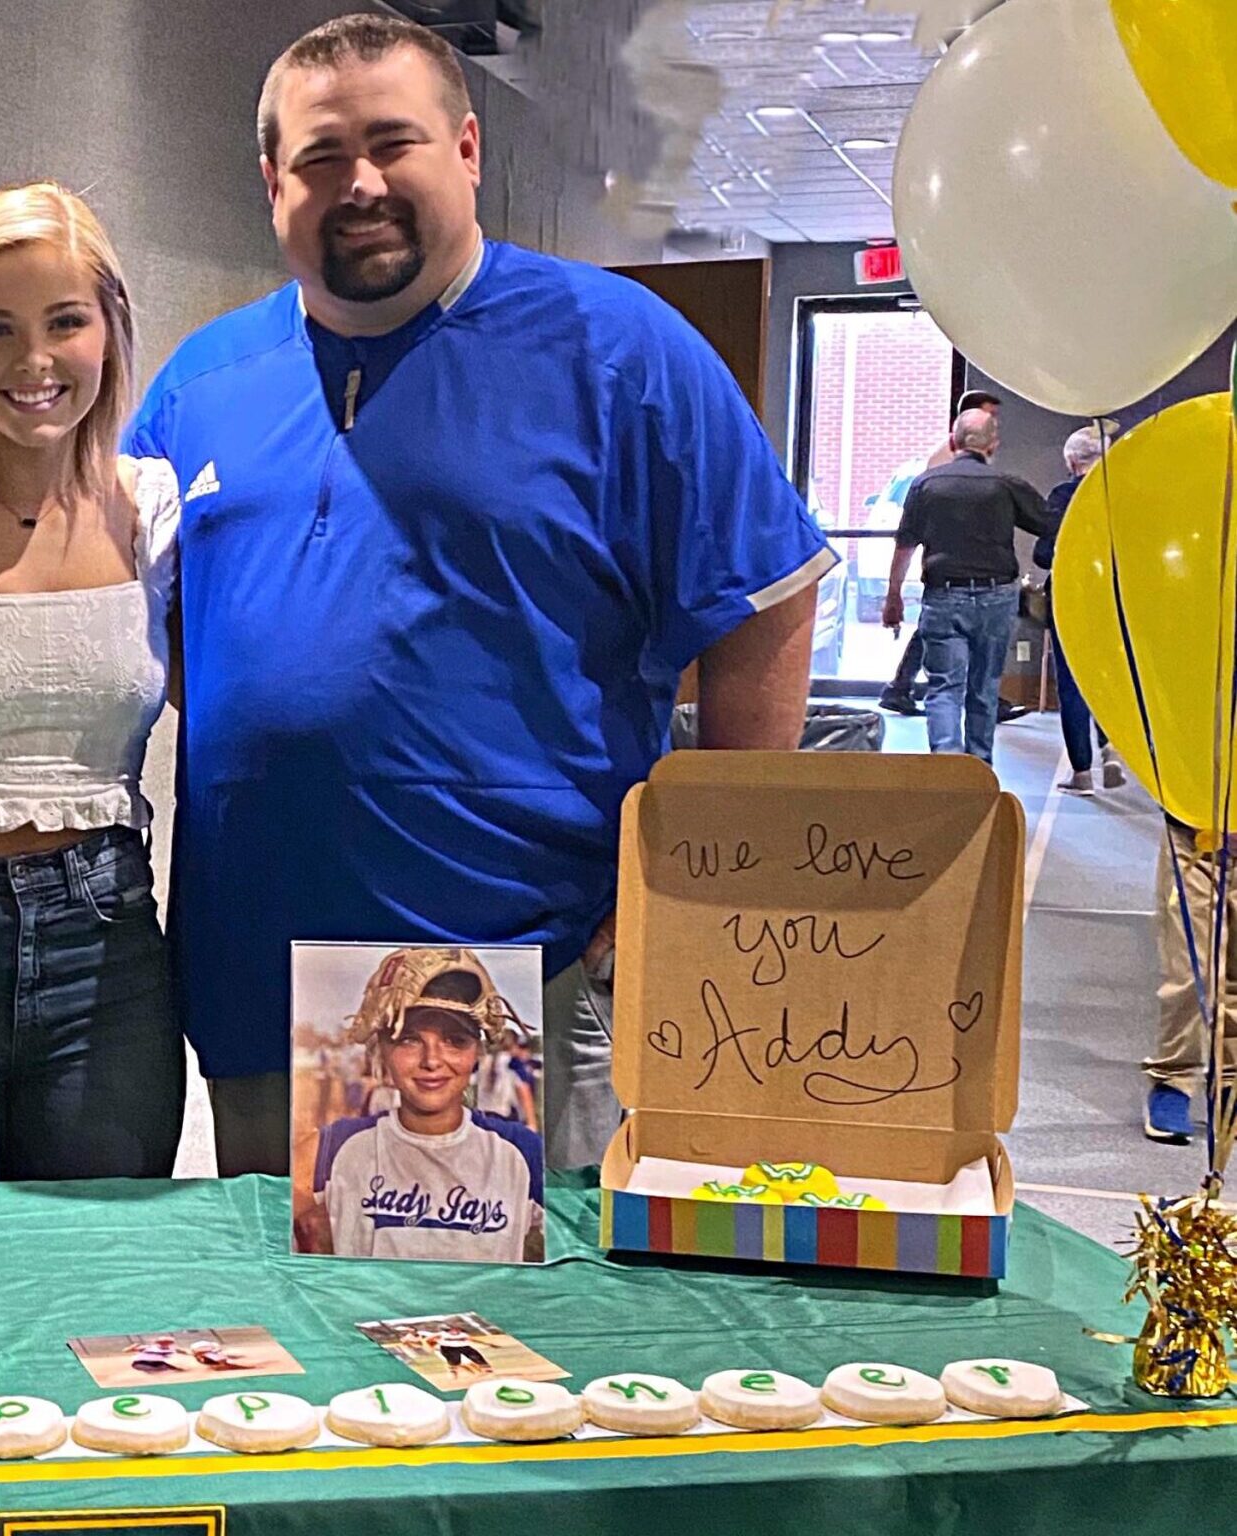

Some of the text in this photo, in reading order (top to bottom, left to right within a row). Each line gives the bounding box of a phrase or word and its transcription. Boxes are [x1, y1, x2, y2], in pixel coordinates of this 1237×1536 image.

[794, 823, 926, 880] love
[723, 913, 885, 986] you
[694, 979, 961, 1105] Addy
[361, 1175, 504, 1235] Lady Jays
